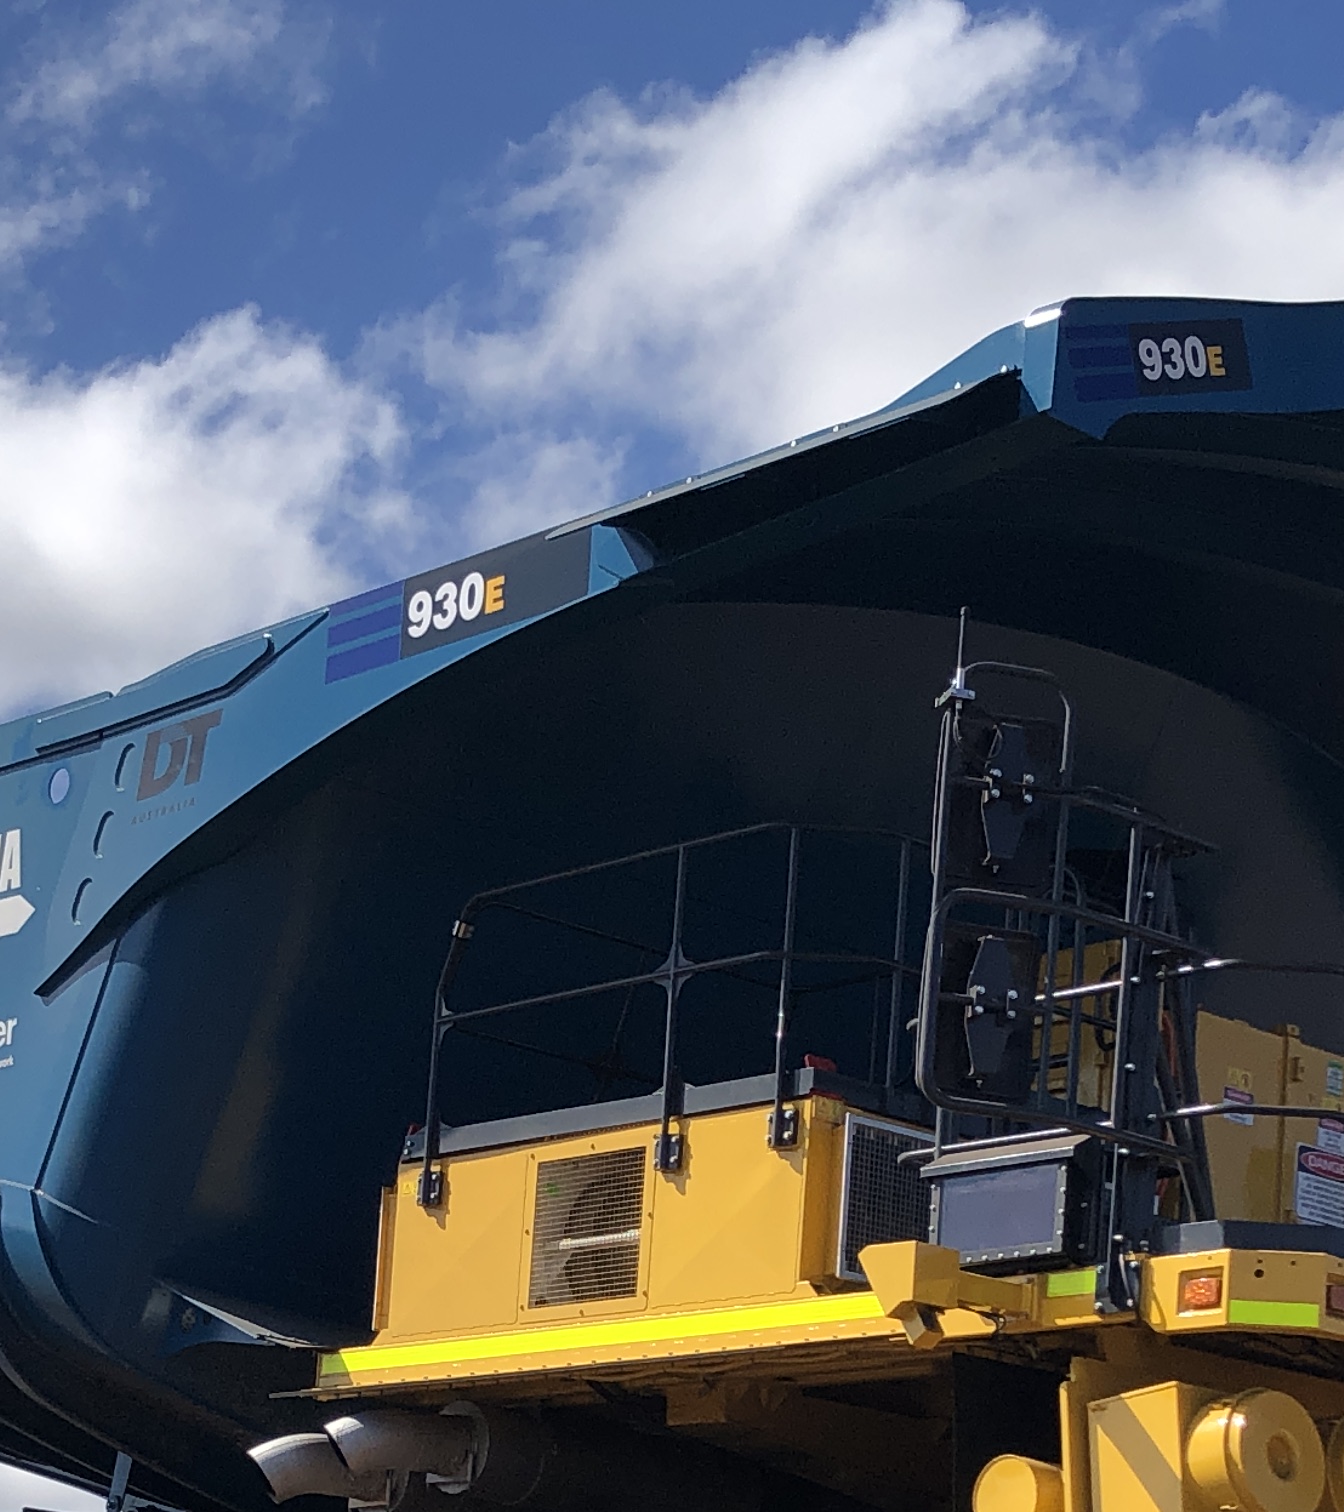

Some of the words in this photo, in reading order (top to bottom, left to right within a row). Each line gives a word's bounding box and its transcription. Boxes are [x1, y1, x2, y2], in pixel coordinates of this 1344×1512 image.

[1138, 335, 1226, 381] 930E
[407, 571, 506, 639] 930E
[136, 707, 224, 802] DT
